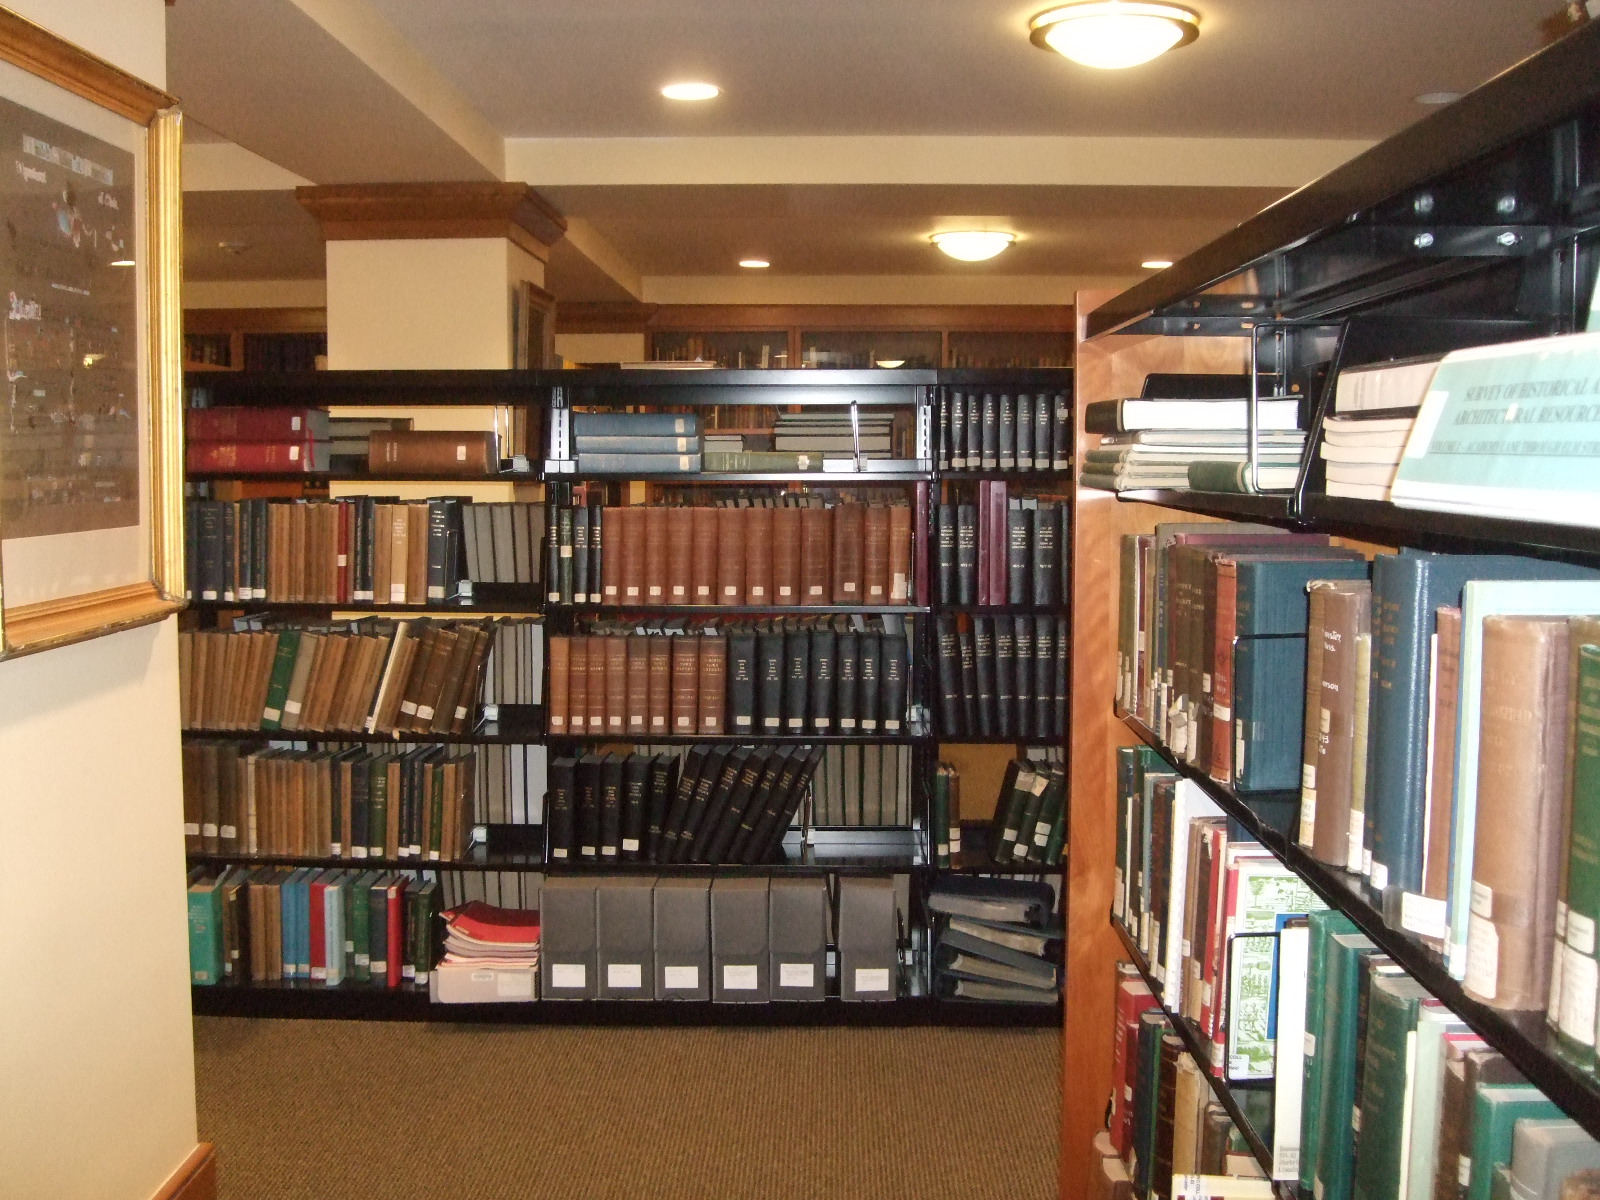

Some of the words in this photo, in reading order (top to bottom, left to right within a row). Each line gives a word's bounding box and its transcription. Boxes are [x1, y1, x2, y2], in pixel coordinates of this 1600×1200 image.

[1465, 385, 1502, 401] SURVEY
[1503, 383, 1518, 400] OF
[1518, 378, 1590, 398] HISTORICAL
[1454, 407, 1537, 425] ARCHITECTRAL
